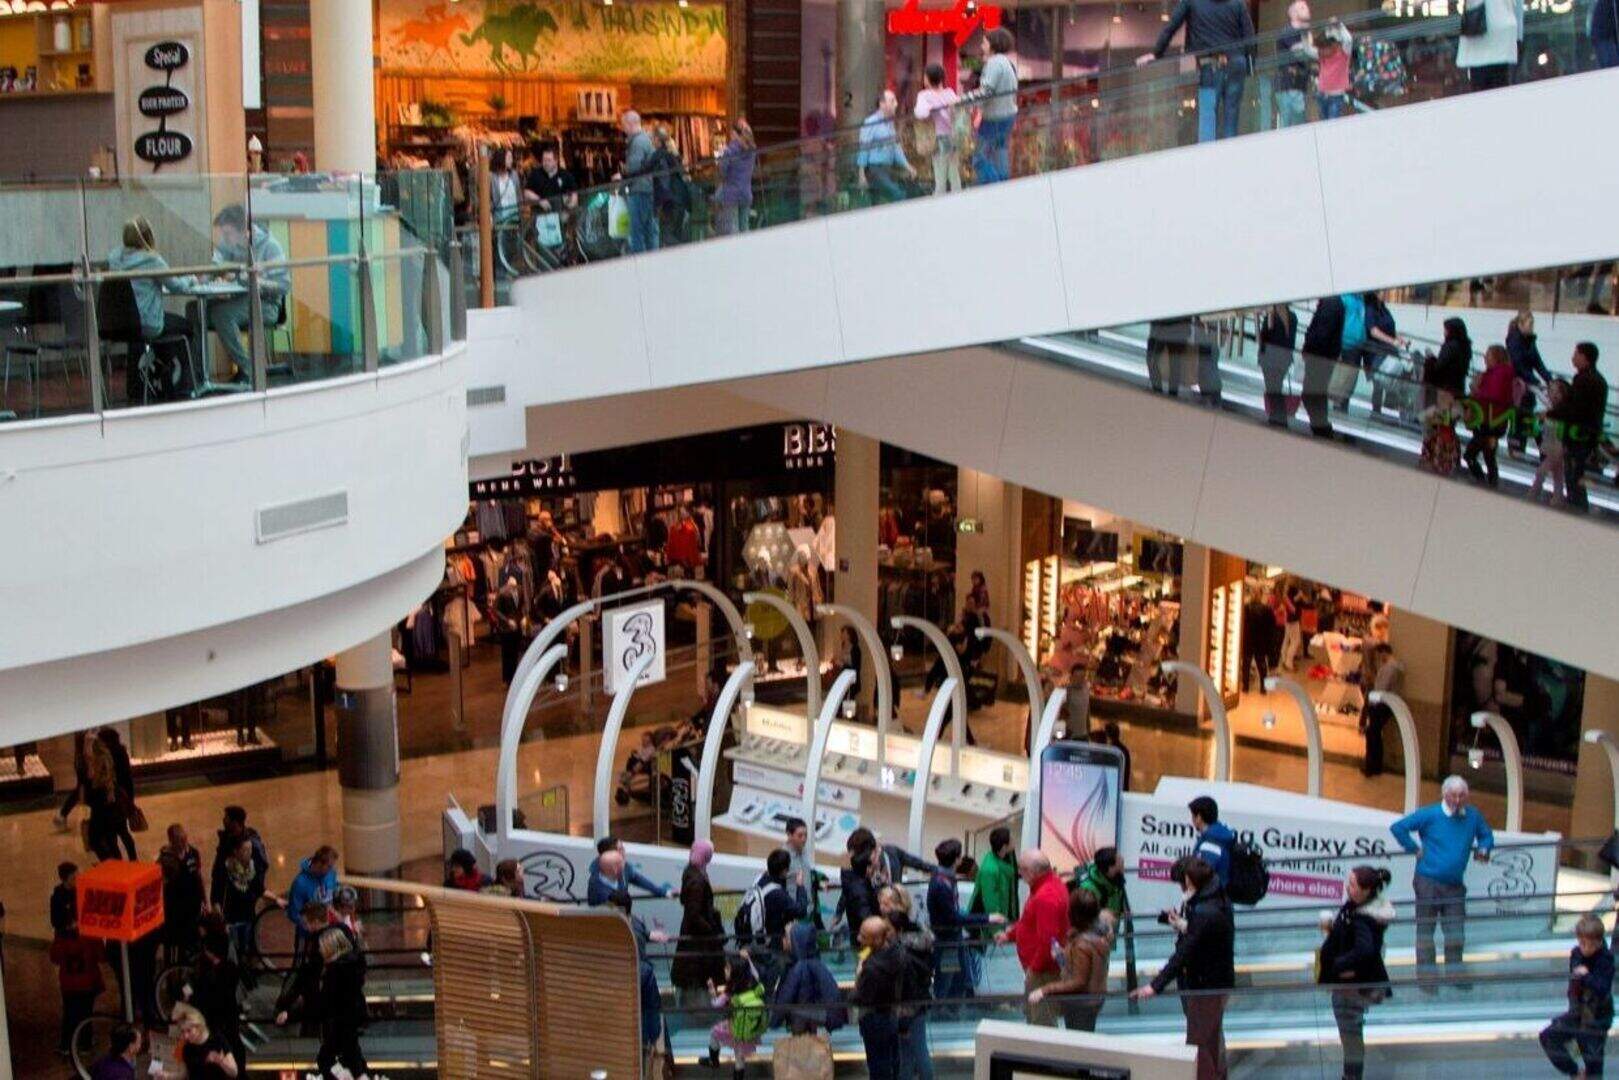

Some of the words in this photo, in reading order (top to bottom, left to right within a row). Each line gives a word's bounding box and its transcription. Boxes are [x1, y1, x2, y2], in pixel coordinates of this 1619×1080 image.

[146, 138, 182, 156] FLOUR
[1140, 841, 1159, 855] All
[1263, 827, 1346, 857] Galaxy
